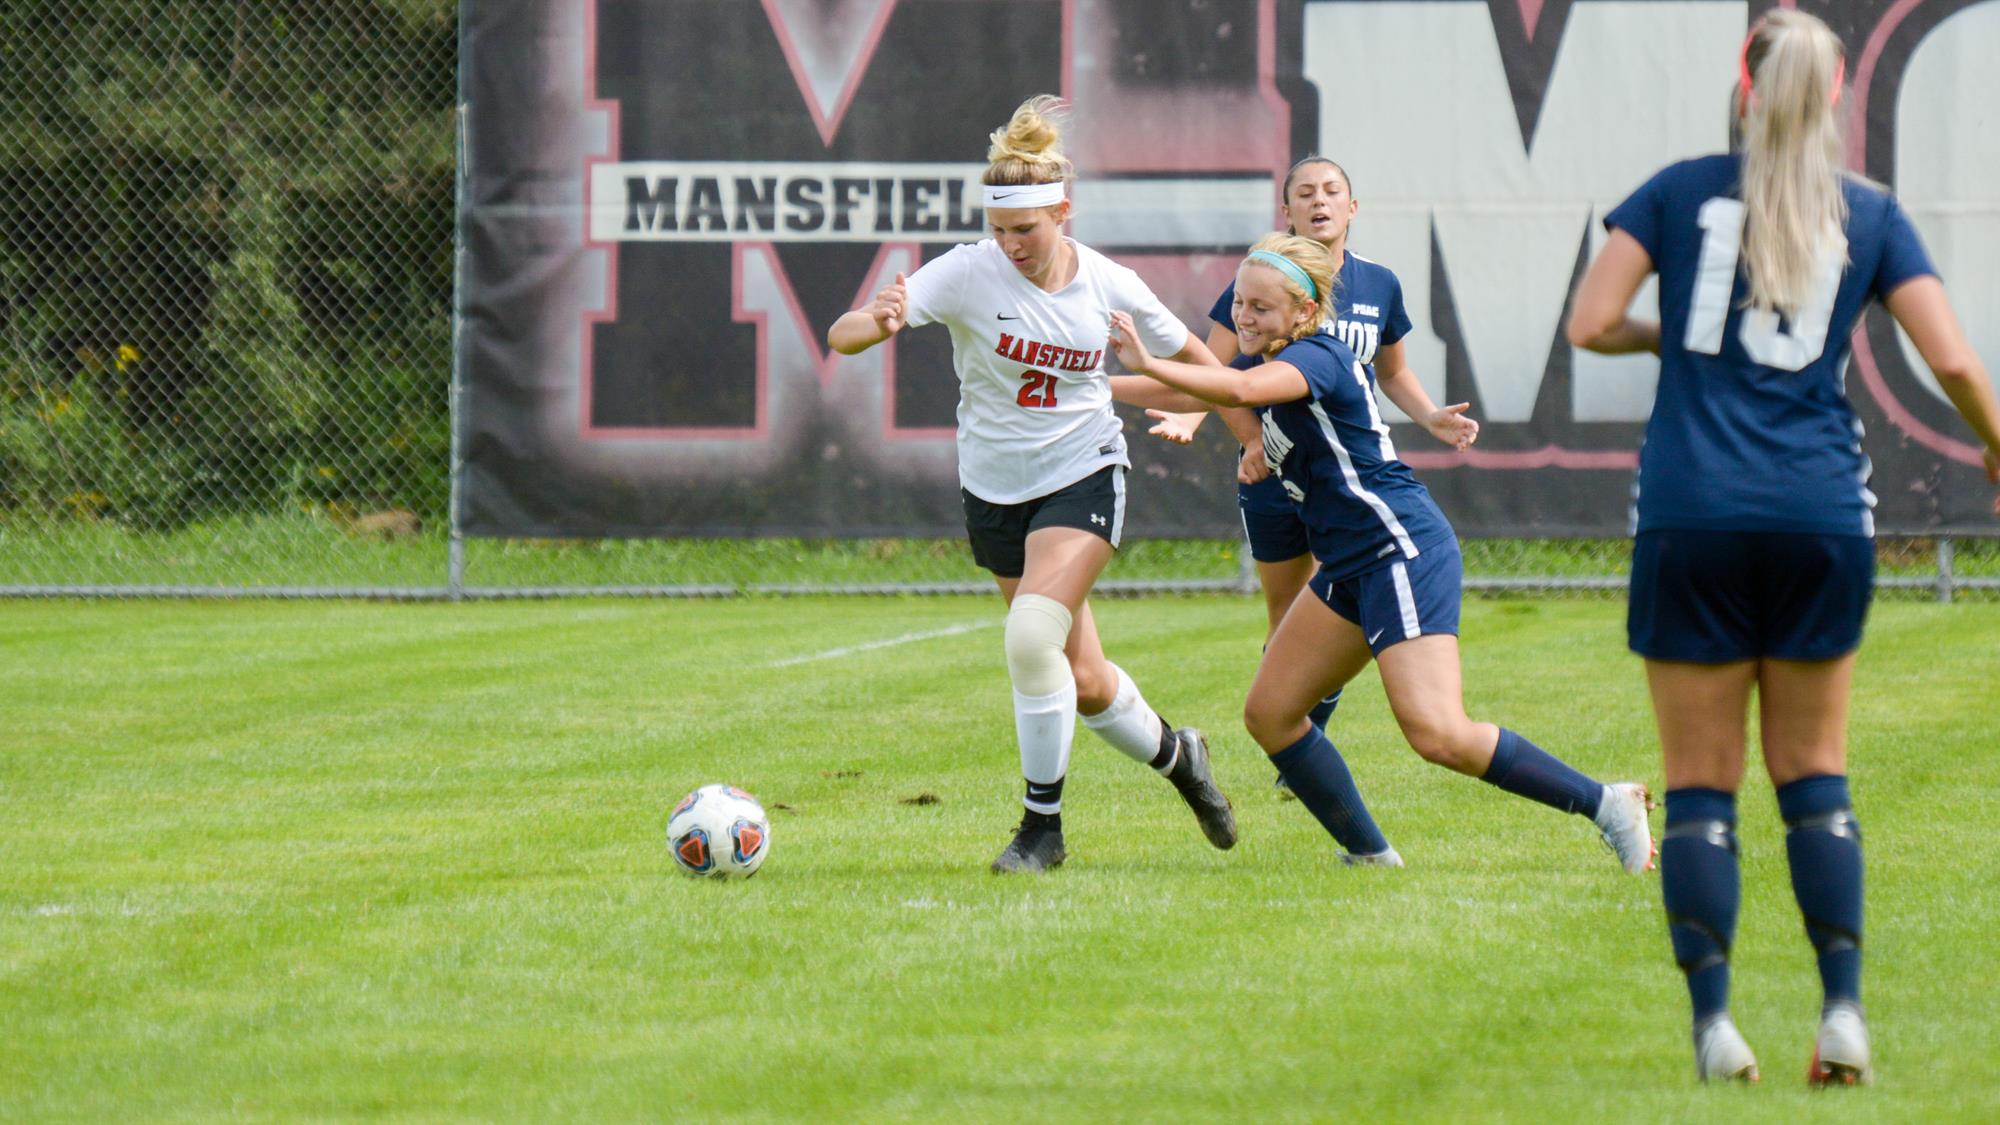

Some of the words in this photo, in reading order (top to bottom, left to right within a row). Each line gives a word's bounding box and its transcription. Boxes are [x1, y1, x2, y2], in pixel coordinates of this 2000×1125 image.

[624, 176, 984, 233] MANSFIEL
[995, 332, 1102, 372] MANSFIELD
[1016, 370, 1059, 408] 21
